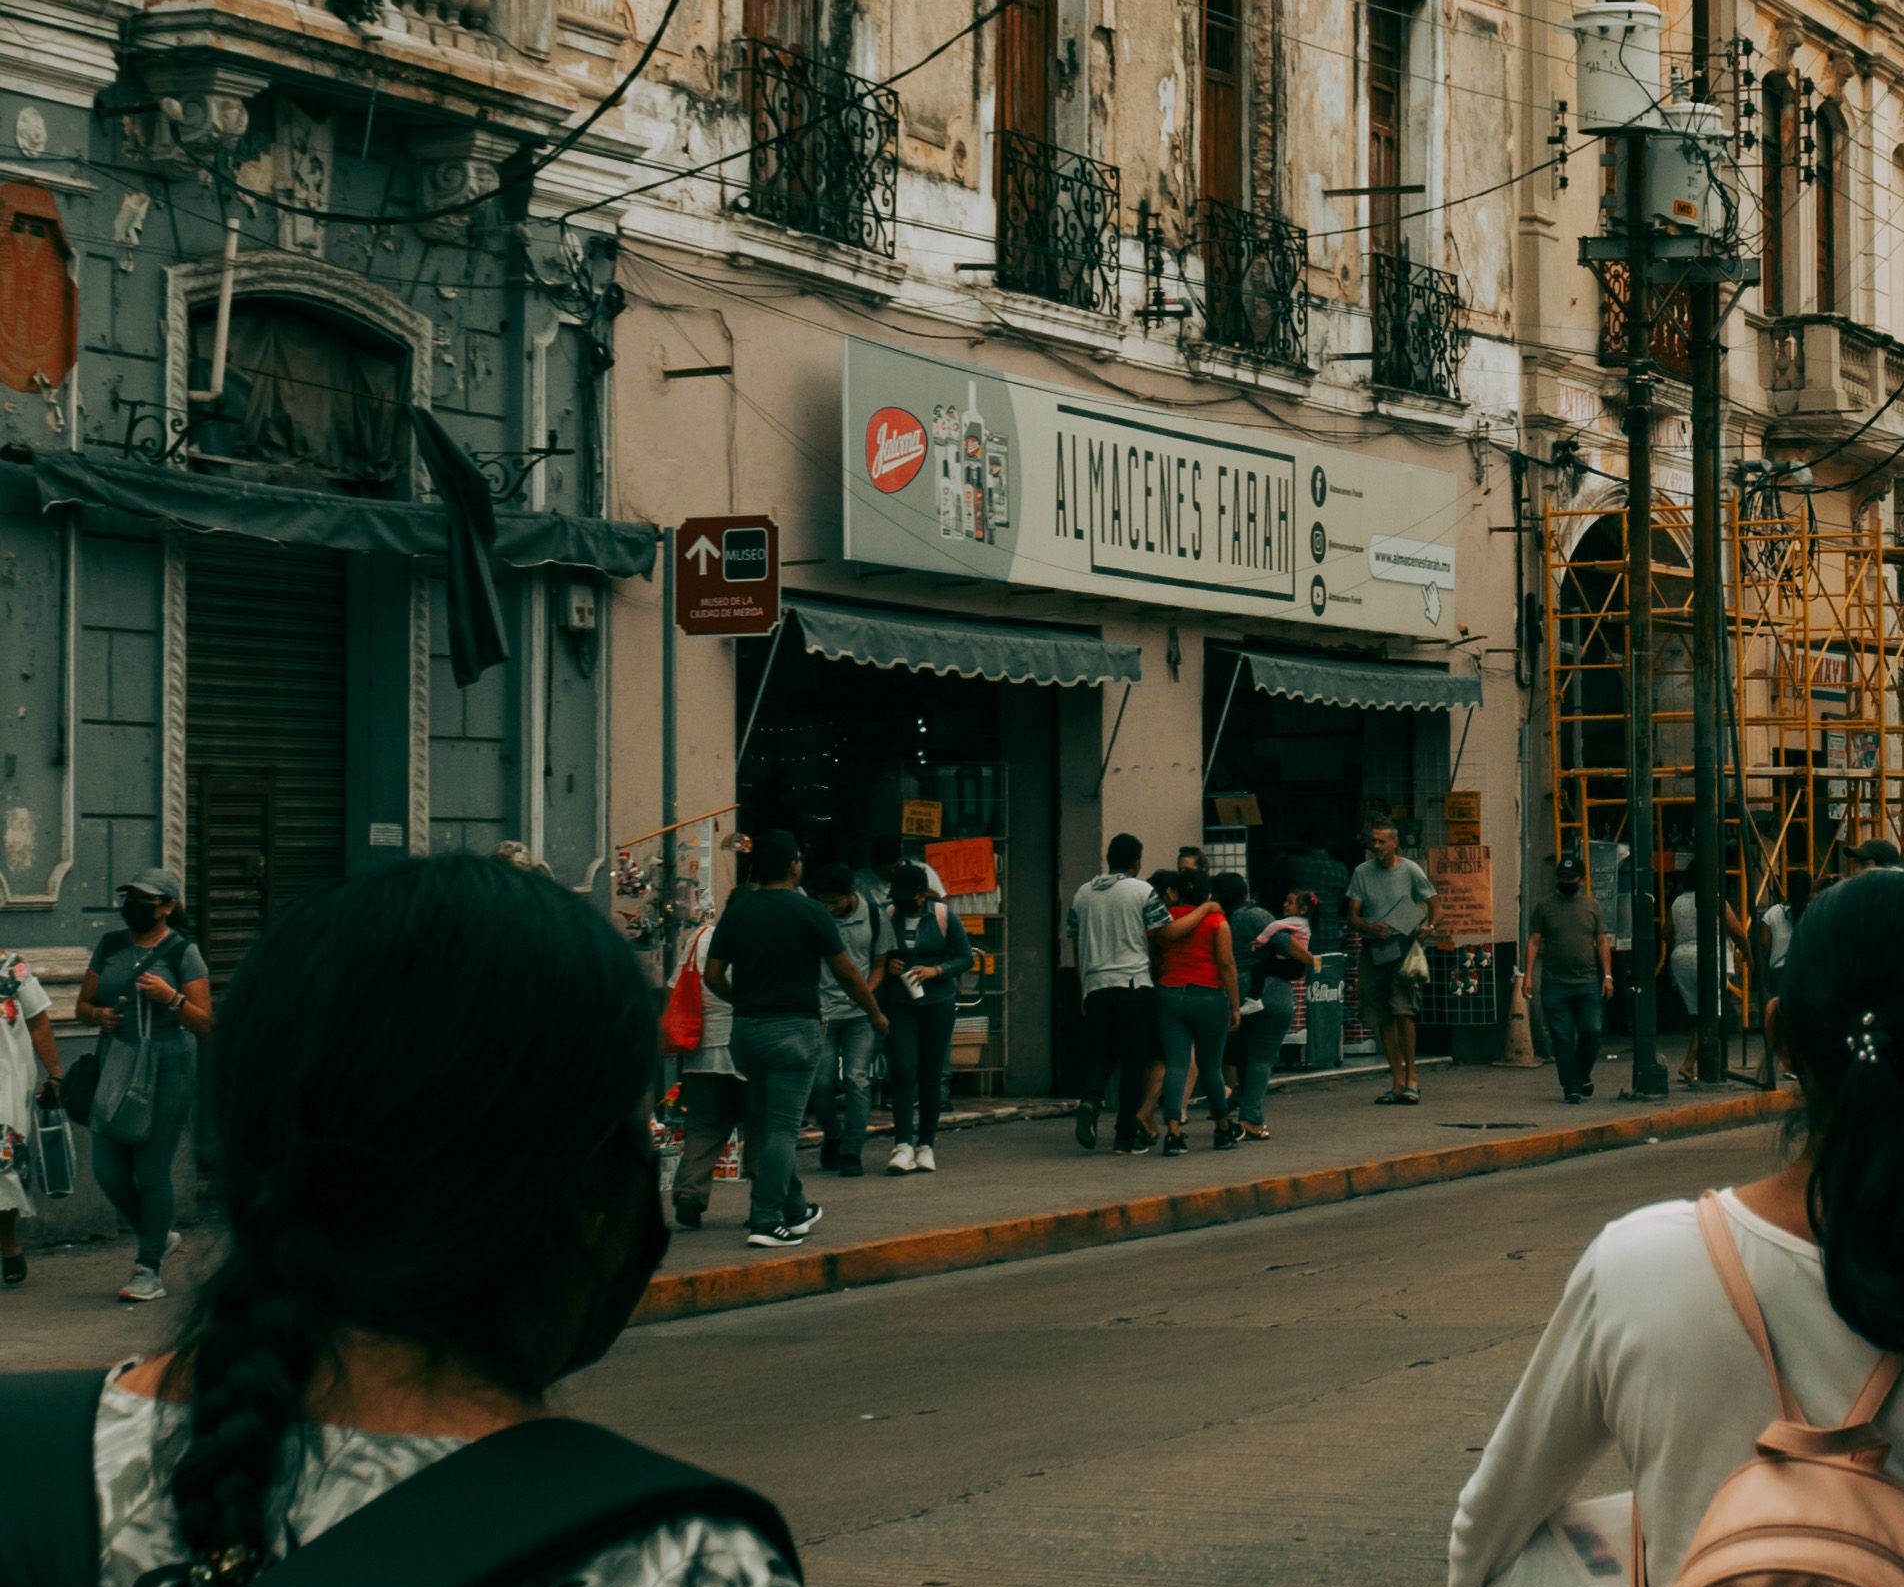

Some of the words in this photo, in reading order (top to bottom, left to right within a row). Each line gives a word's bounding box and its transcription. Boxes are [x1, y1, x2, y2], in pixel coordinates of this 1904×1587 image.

[872, 422, 924, 479] Jaloma
[1056, 431, 1201, 564] ALMACENES
[1218, 465, 1289, 574] FARAH
[727, 548, 766, 561] MUSEO
[701, 598, 729, 607] MUSEO
[731, 597, 741, 606] DE
[742, 596, 754, 605] LA
[690, 609, 719, 619] CIUDAD
[721, 608, 732, 617] DE
